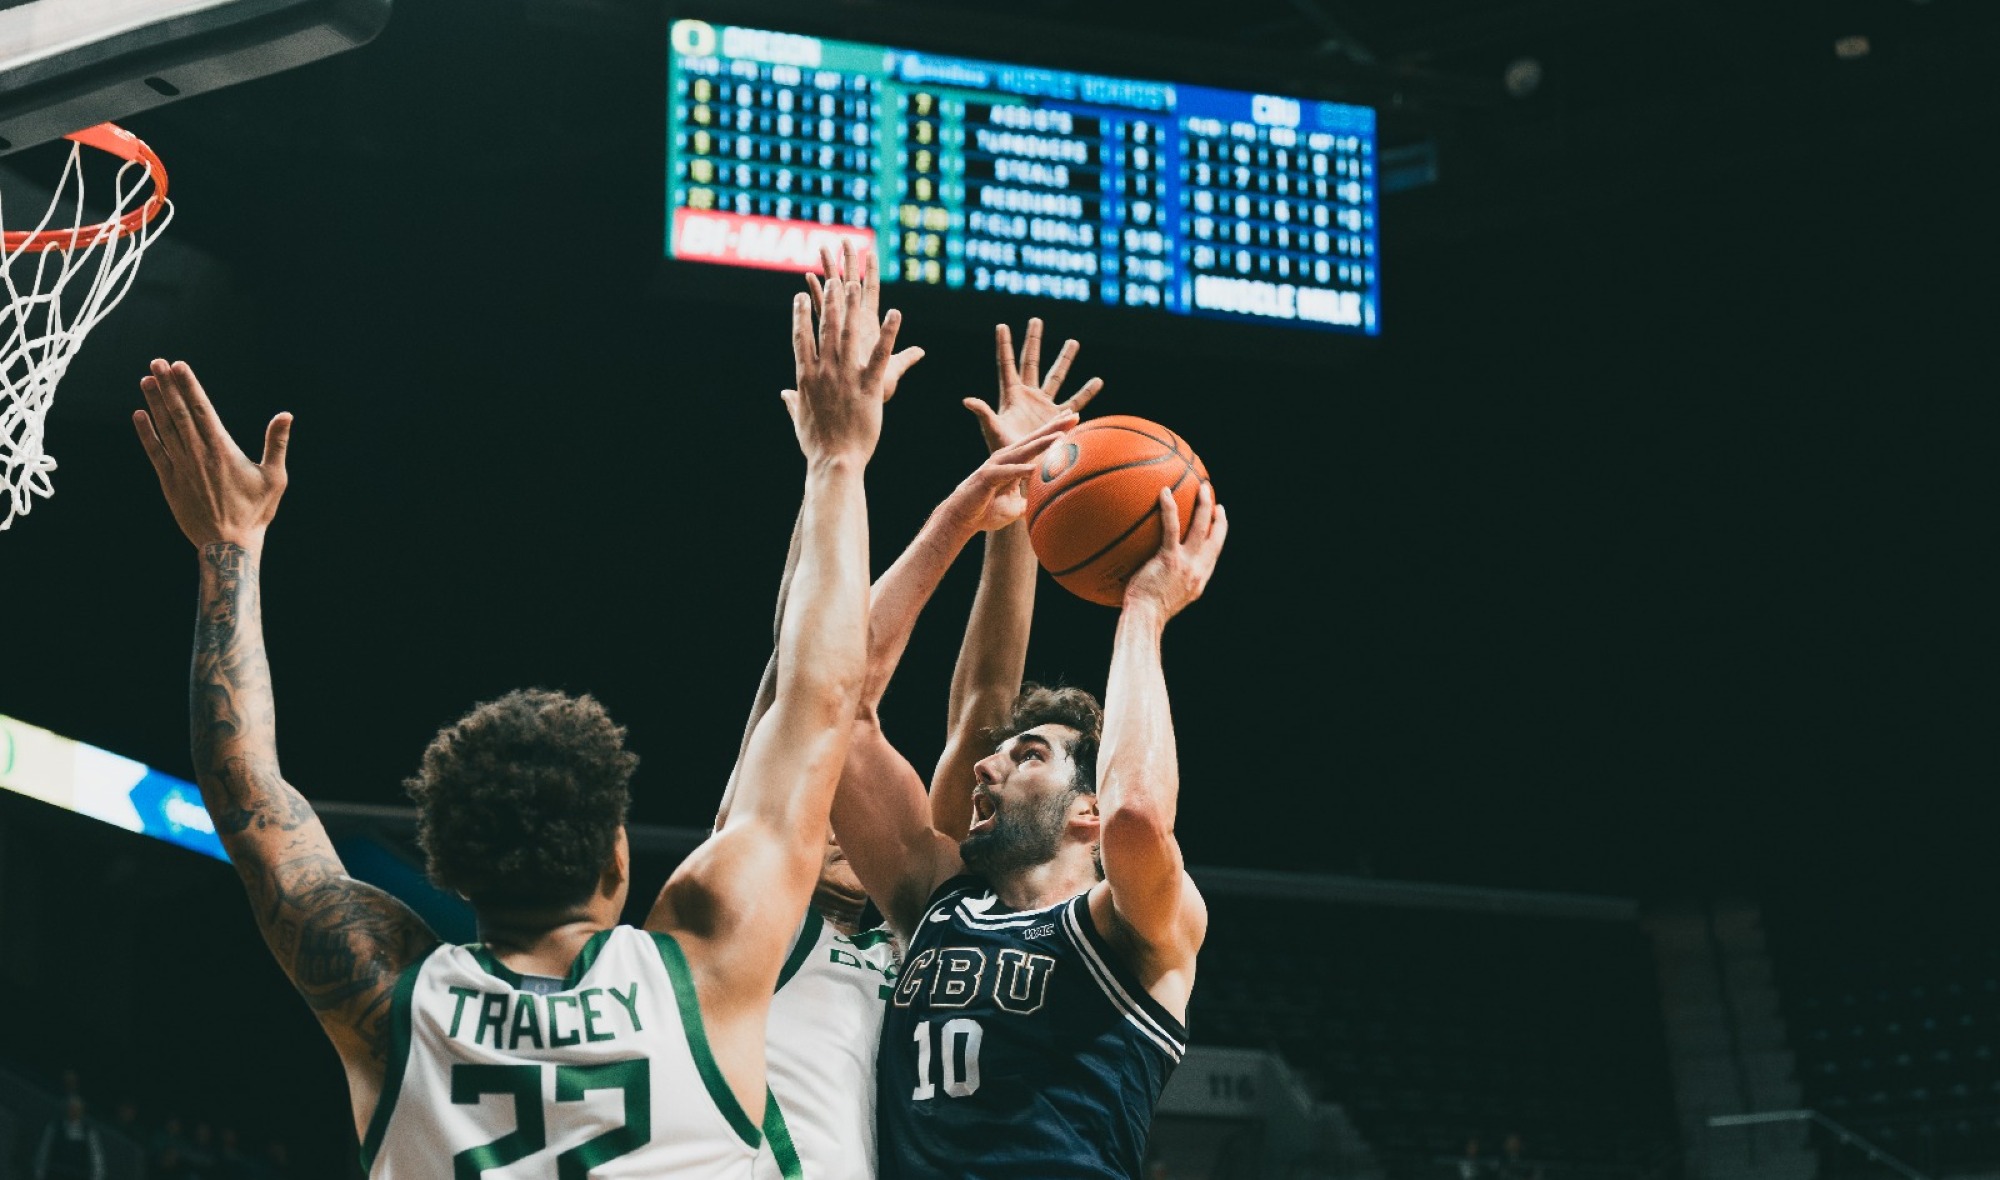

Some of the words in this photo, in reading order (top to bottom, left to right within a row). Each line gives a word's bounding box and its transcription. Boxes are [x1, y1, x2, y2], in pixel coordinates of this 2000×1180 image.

[1253, 95, 1300, 127] CBU
[894, 946, 1056, 1015] CBU
[448, 982, 643, 1050] TRACEY
[911, 1018, 984, 1101] 10
[451, 1058, 651, 1180] 22
